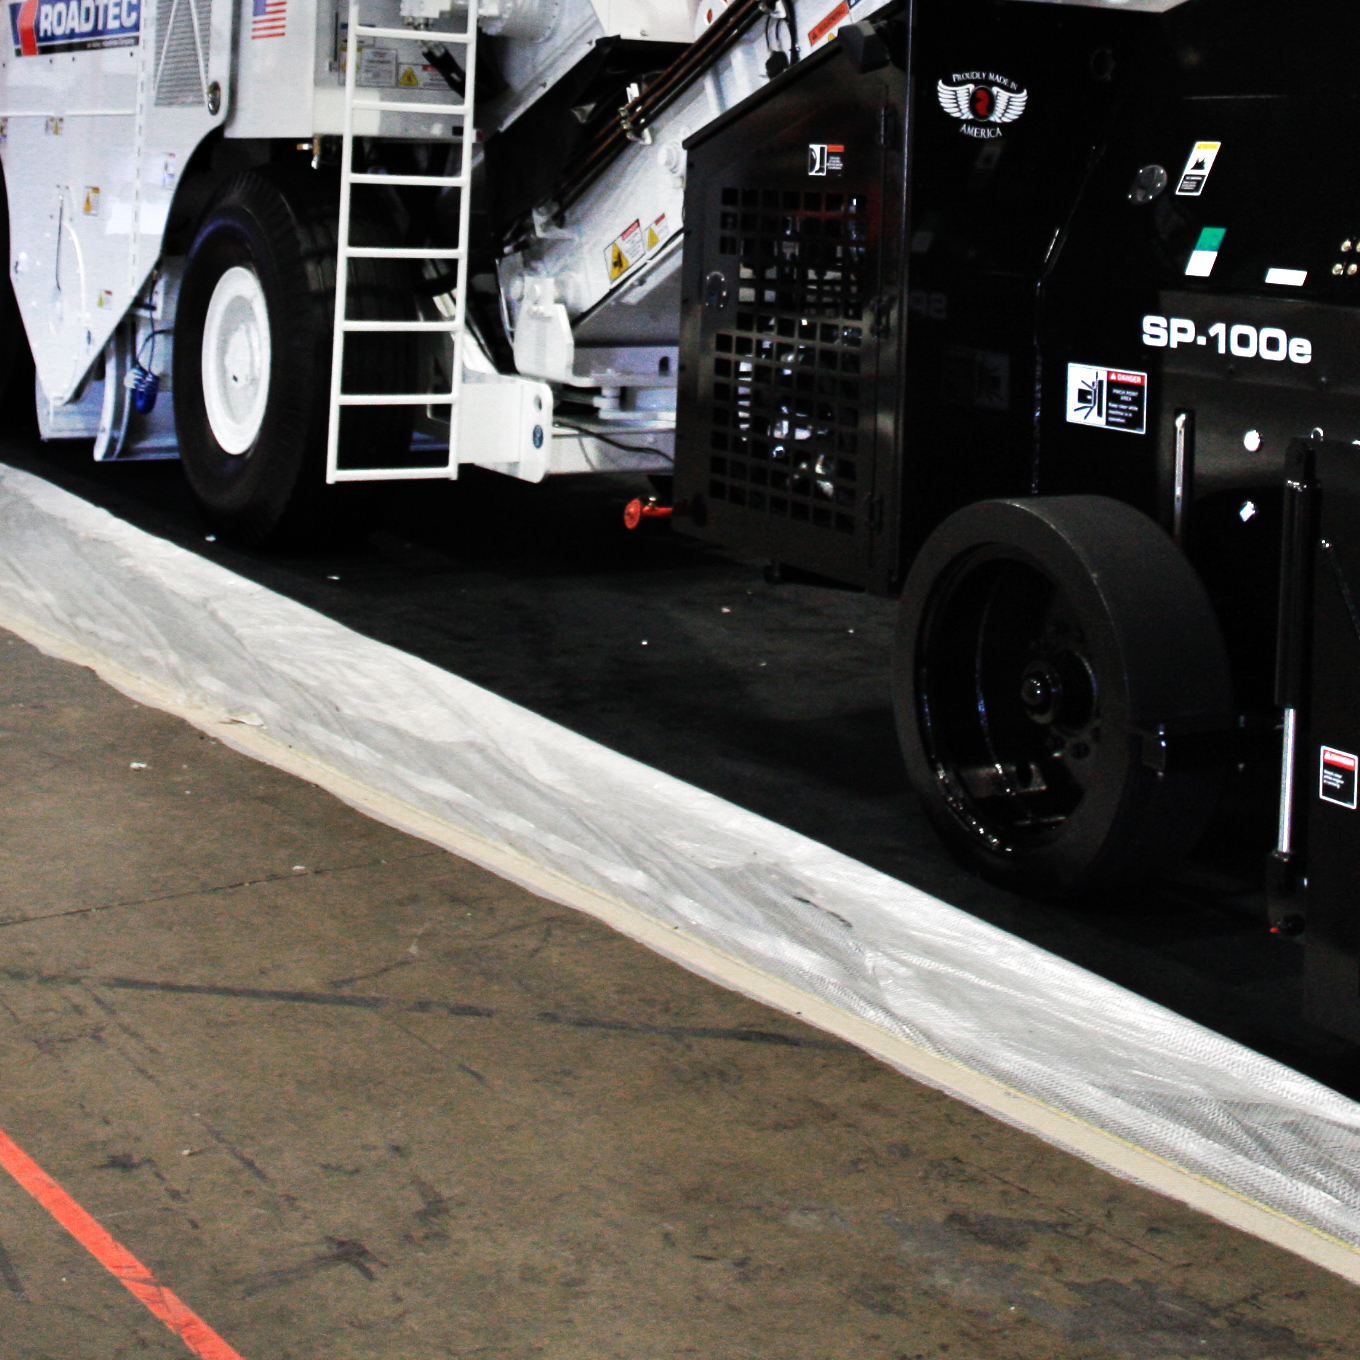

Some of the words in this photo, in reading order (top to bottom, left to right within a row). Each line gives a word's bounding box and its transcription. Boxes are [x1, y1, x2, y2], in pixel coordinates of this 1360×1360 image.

[952, 71, 987, 82] PROUDLY
[988, 72, 1009, 87] MADE
[1010, 81, 1019, 90] IN
[960, 123, 1003, 139] AMERICA
[1142, 315, 1312, 364] SP-100e
